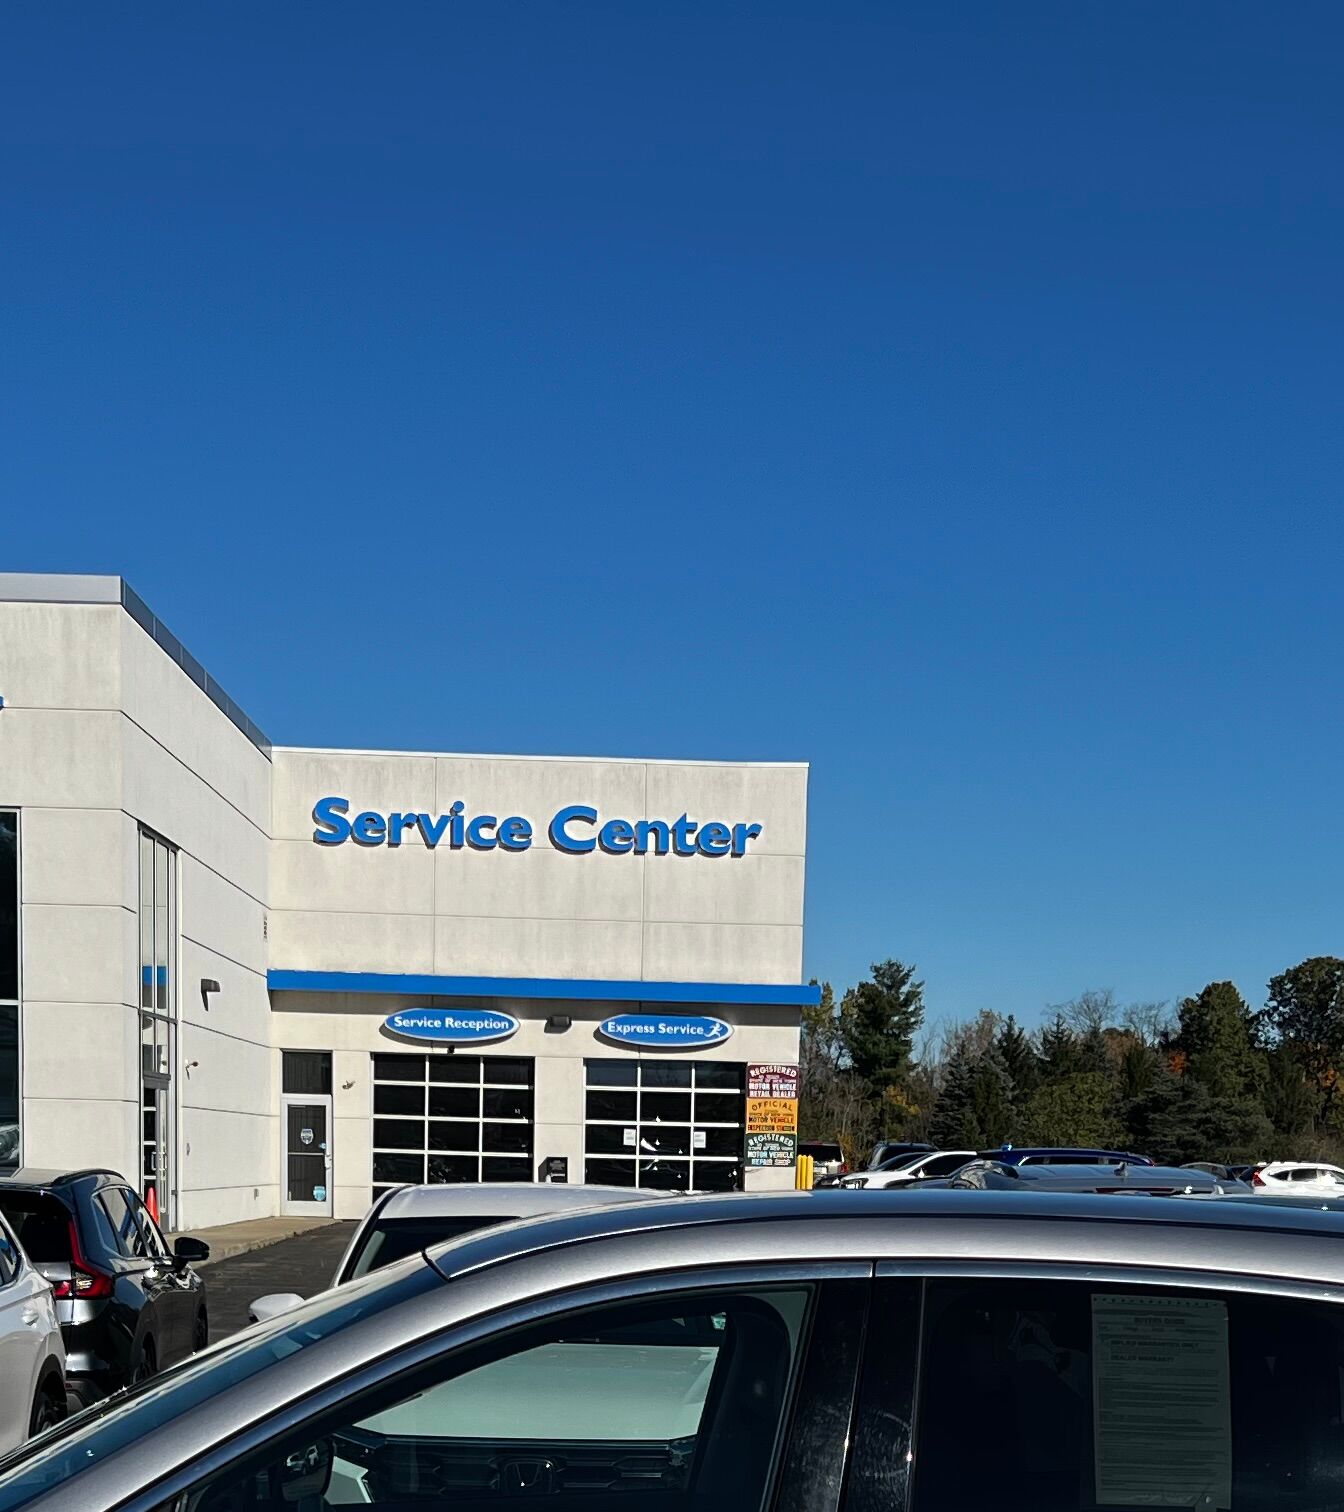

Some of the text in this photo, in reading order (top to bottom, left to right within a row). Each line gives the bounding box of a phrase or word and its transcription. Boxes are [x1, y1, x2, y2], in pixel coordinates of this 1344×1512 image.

[312, 796, 763, 858] Service Center
[394, 1016, 509, 1031] Service Reception
[607, 1022, 704, 1035] Express Service
[749, 1065, 797, 1078] REGISTERED
[772, 1083, 797, 1091] VEHICLE
[751, 1101, 792, 1111] OFFICIAL
[747, 1133, 794, 1146] REGISTERED
[768, 1151, 794, 1159] VEHICLE
